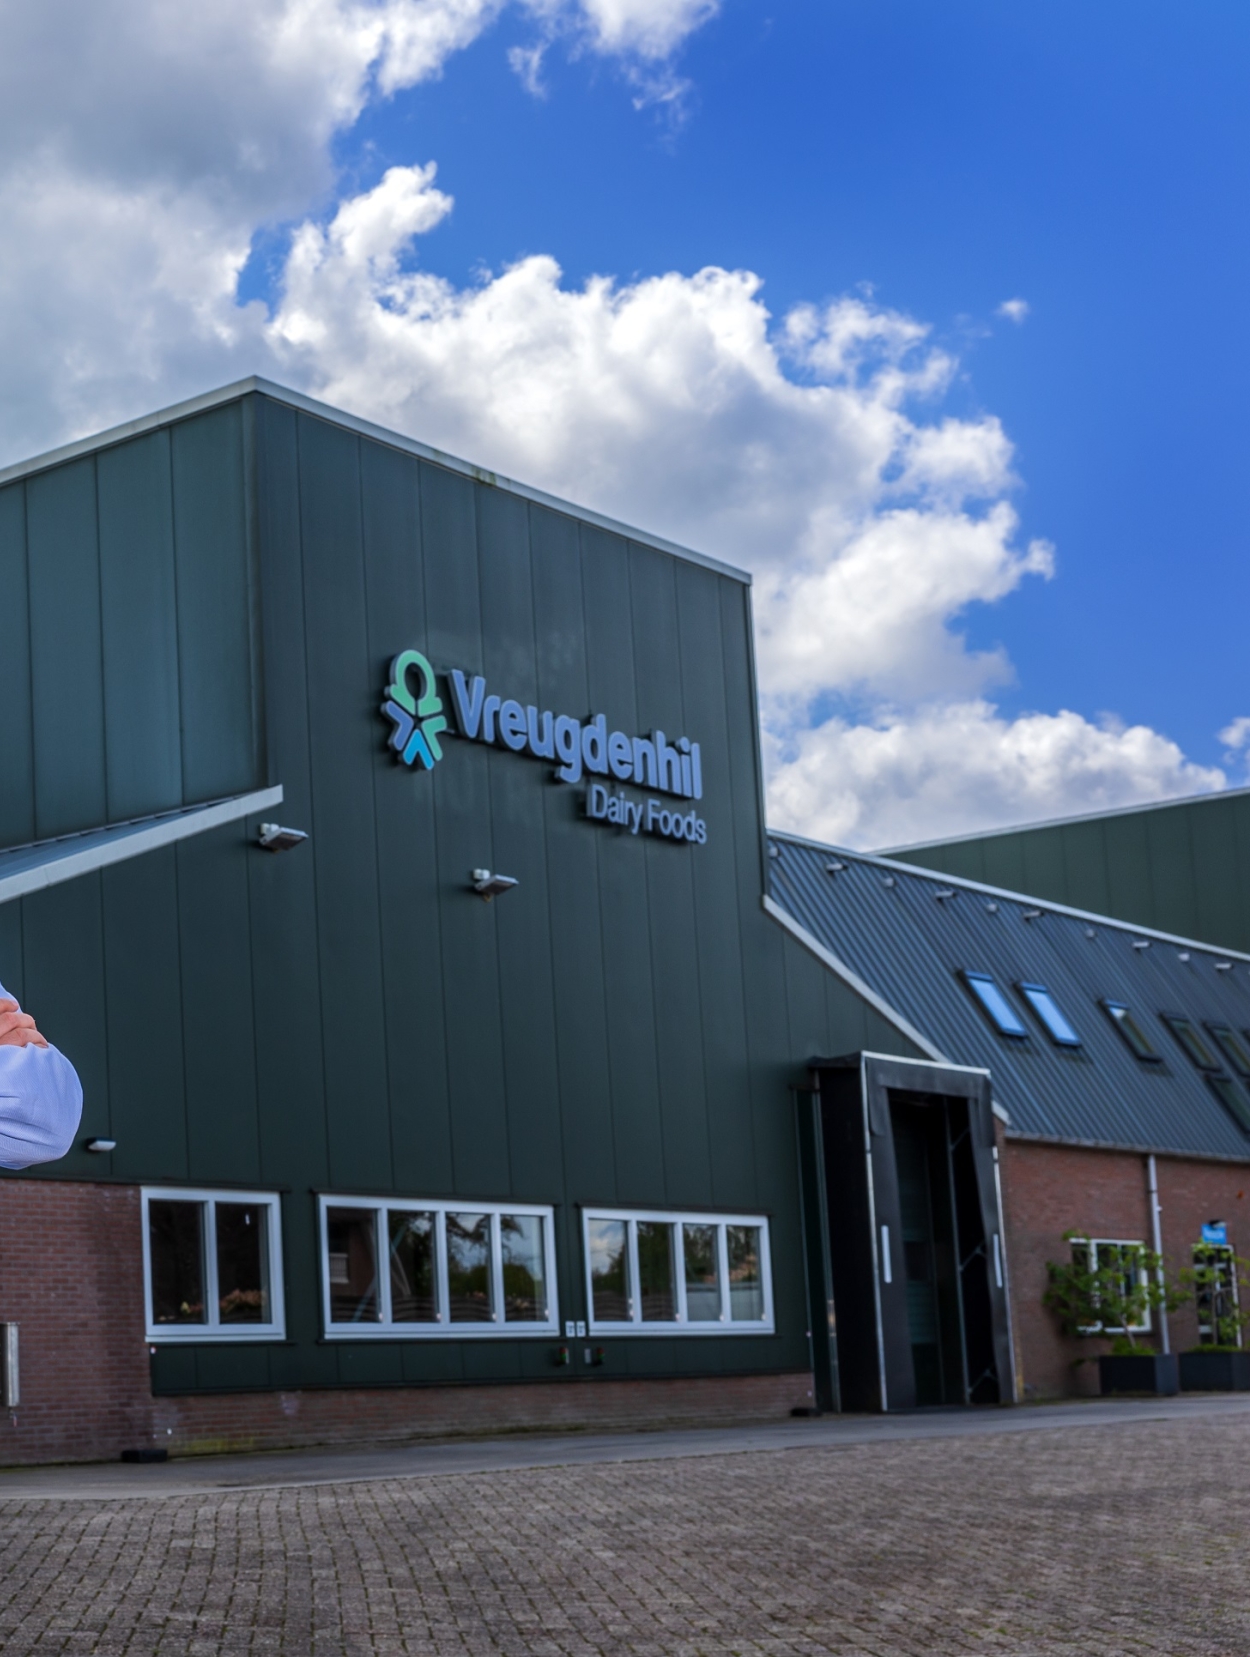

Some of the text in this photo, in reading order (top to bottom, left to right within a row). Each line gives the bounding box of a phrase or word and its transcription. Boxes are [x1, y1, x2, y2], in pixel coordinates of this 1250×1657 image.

[451, 668, 702, 800] Vreugdenhil
[591, 783, 707, 844] Dairy Foods
